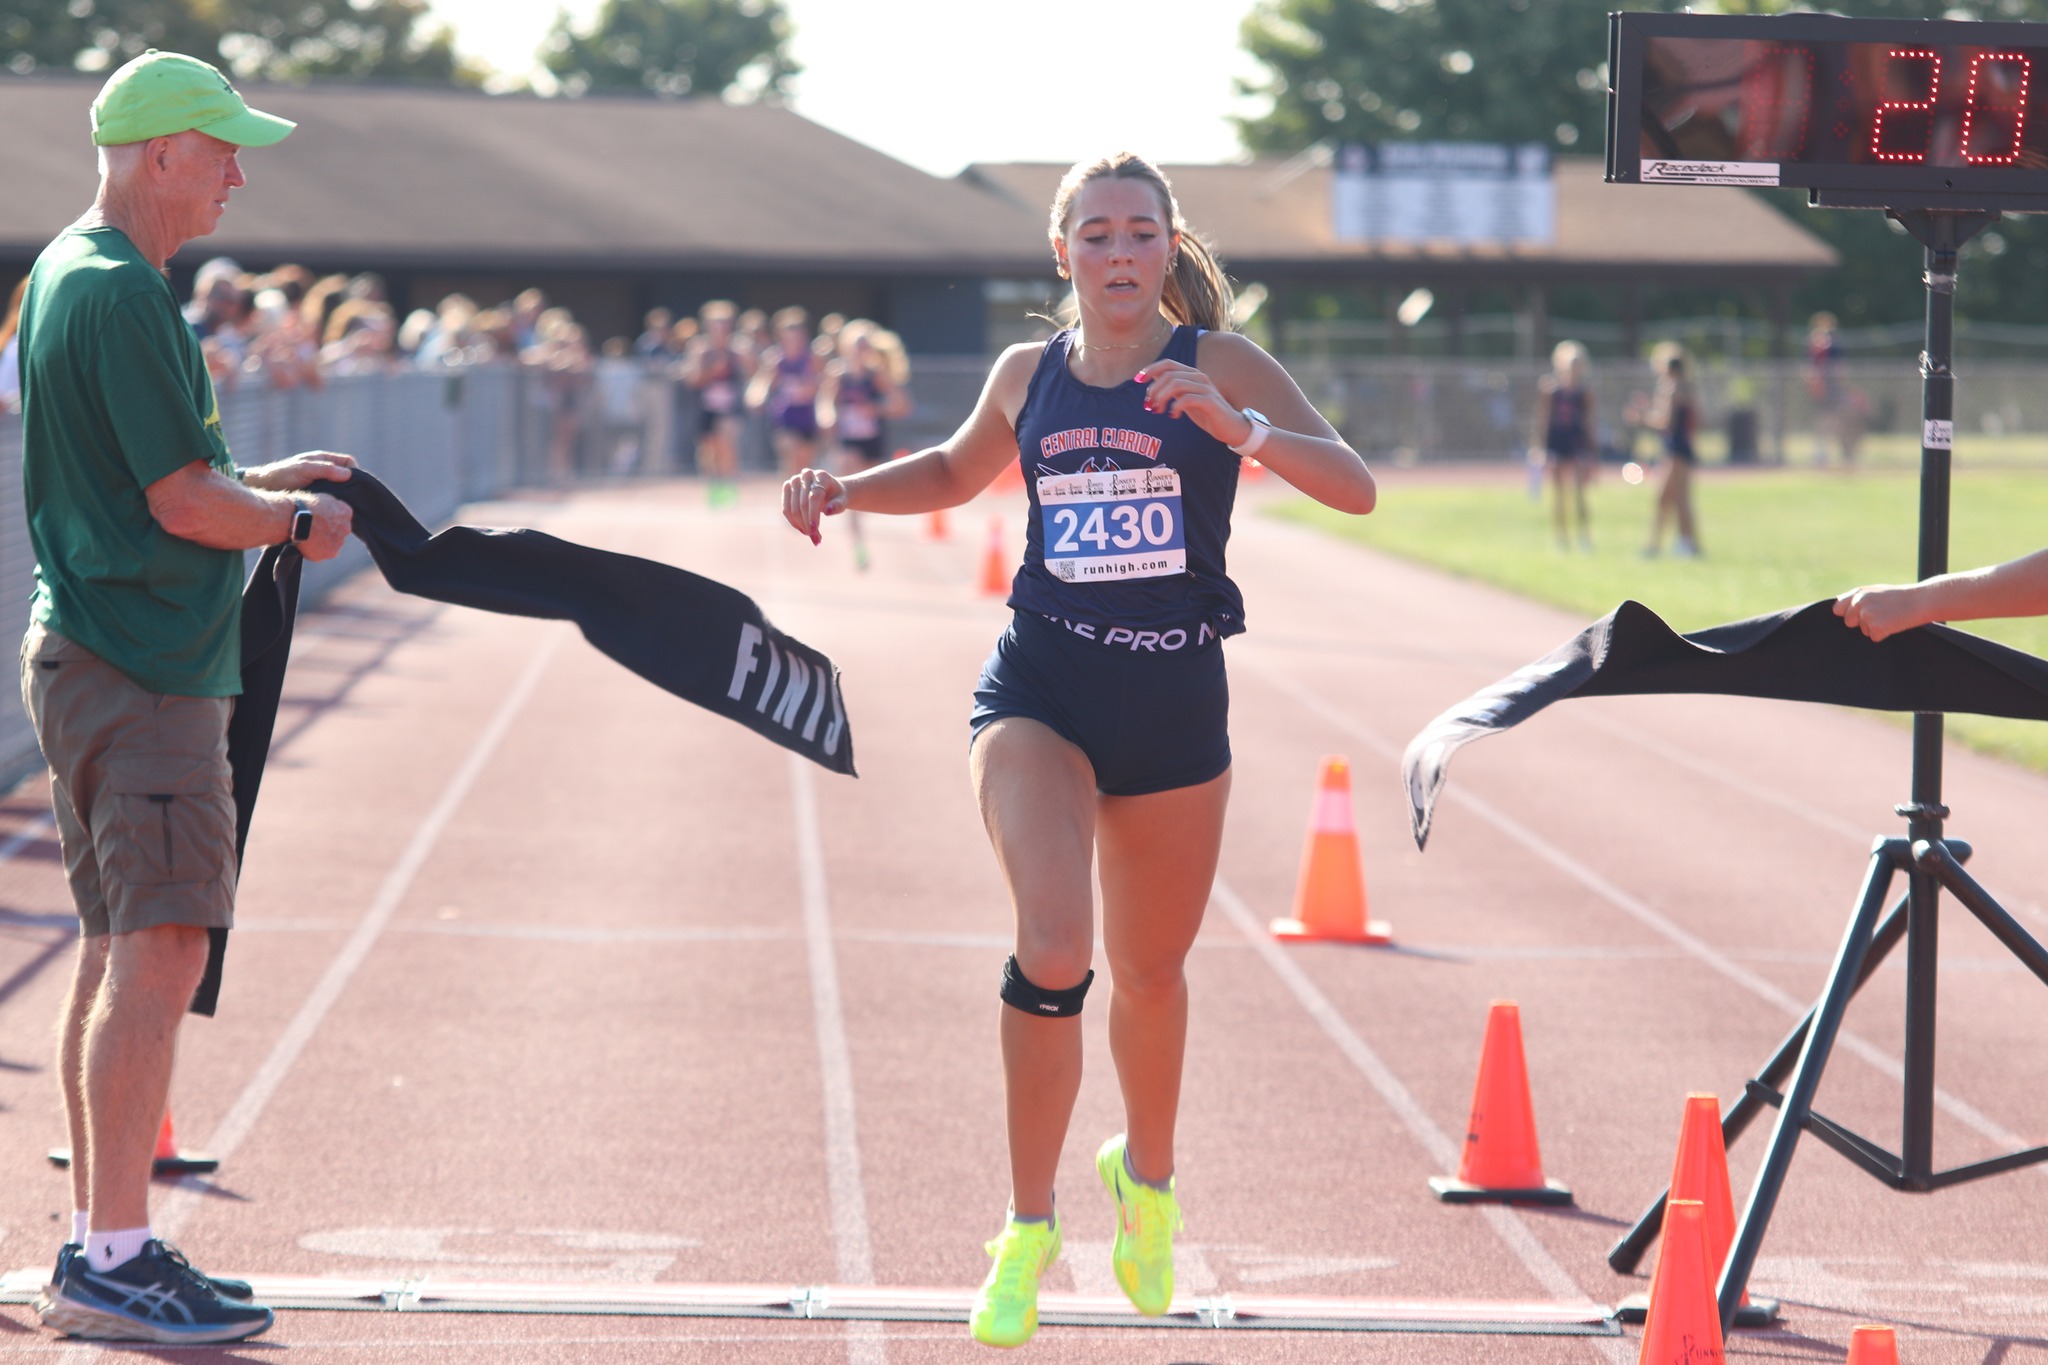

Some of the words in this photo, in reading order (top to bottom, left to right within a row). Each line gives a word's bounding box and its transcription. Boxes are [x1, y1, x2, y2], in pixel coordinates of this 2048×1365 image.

[1871, 50, 2030, 164] 20
[1040, 427, 1100, 459] CENTRAL
[1101, 427, 1163, 461] CLARION
[1053, 502, 1174, 553] 2430
[1083, 560, 1168, 575] runhigh.com
[1103, 627, 1188, 652] PRO
